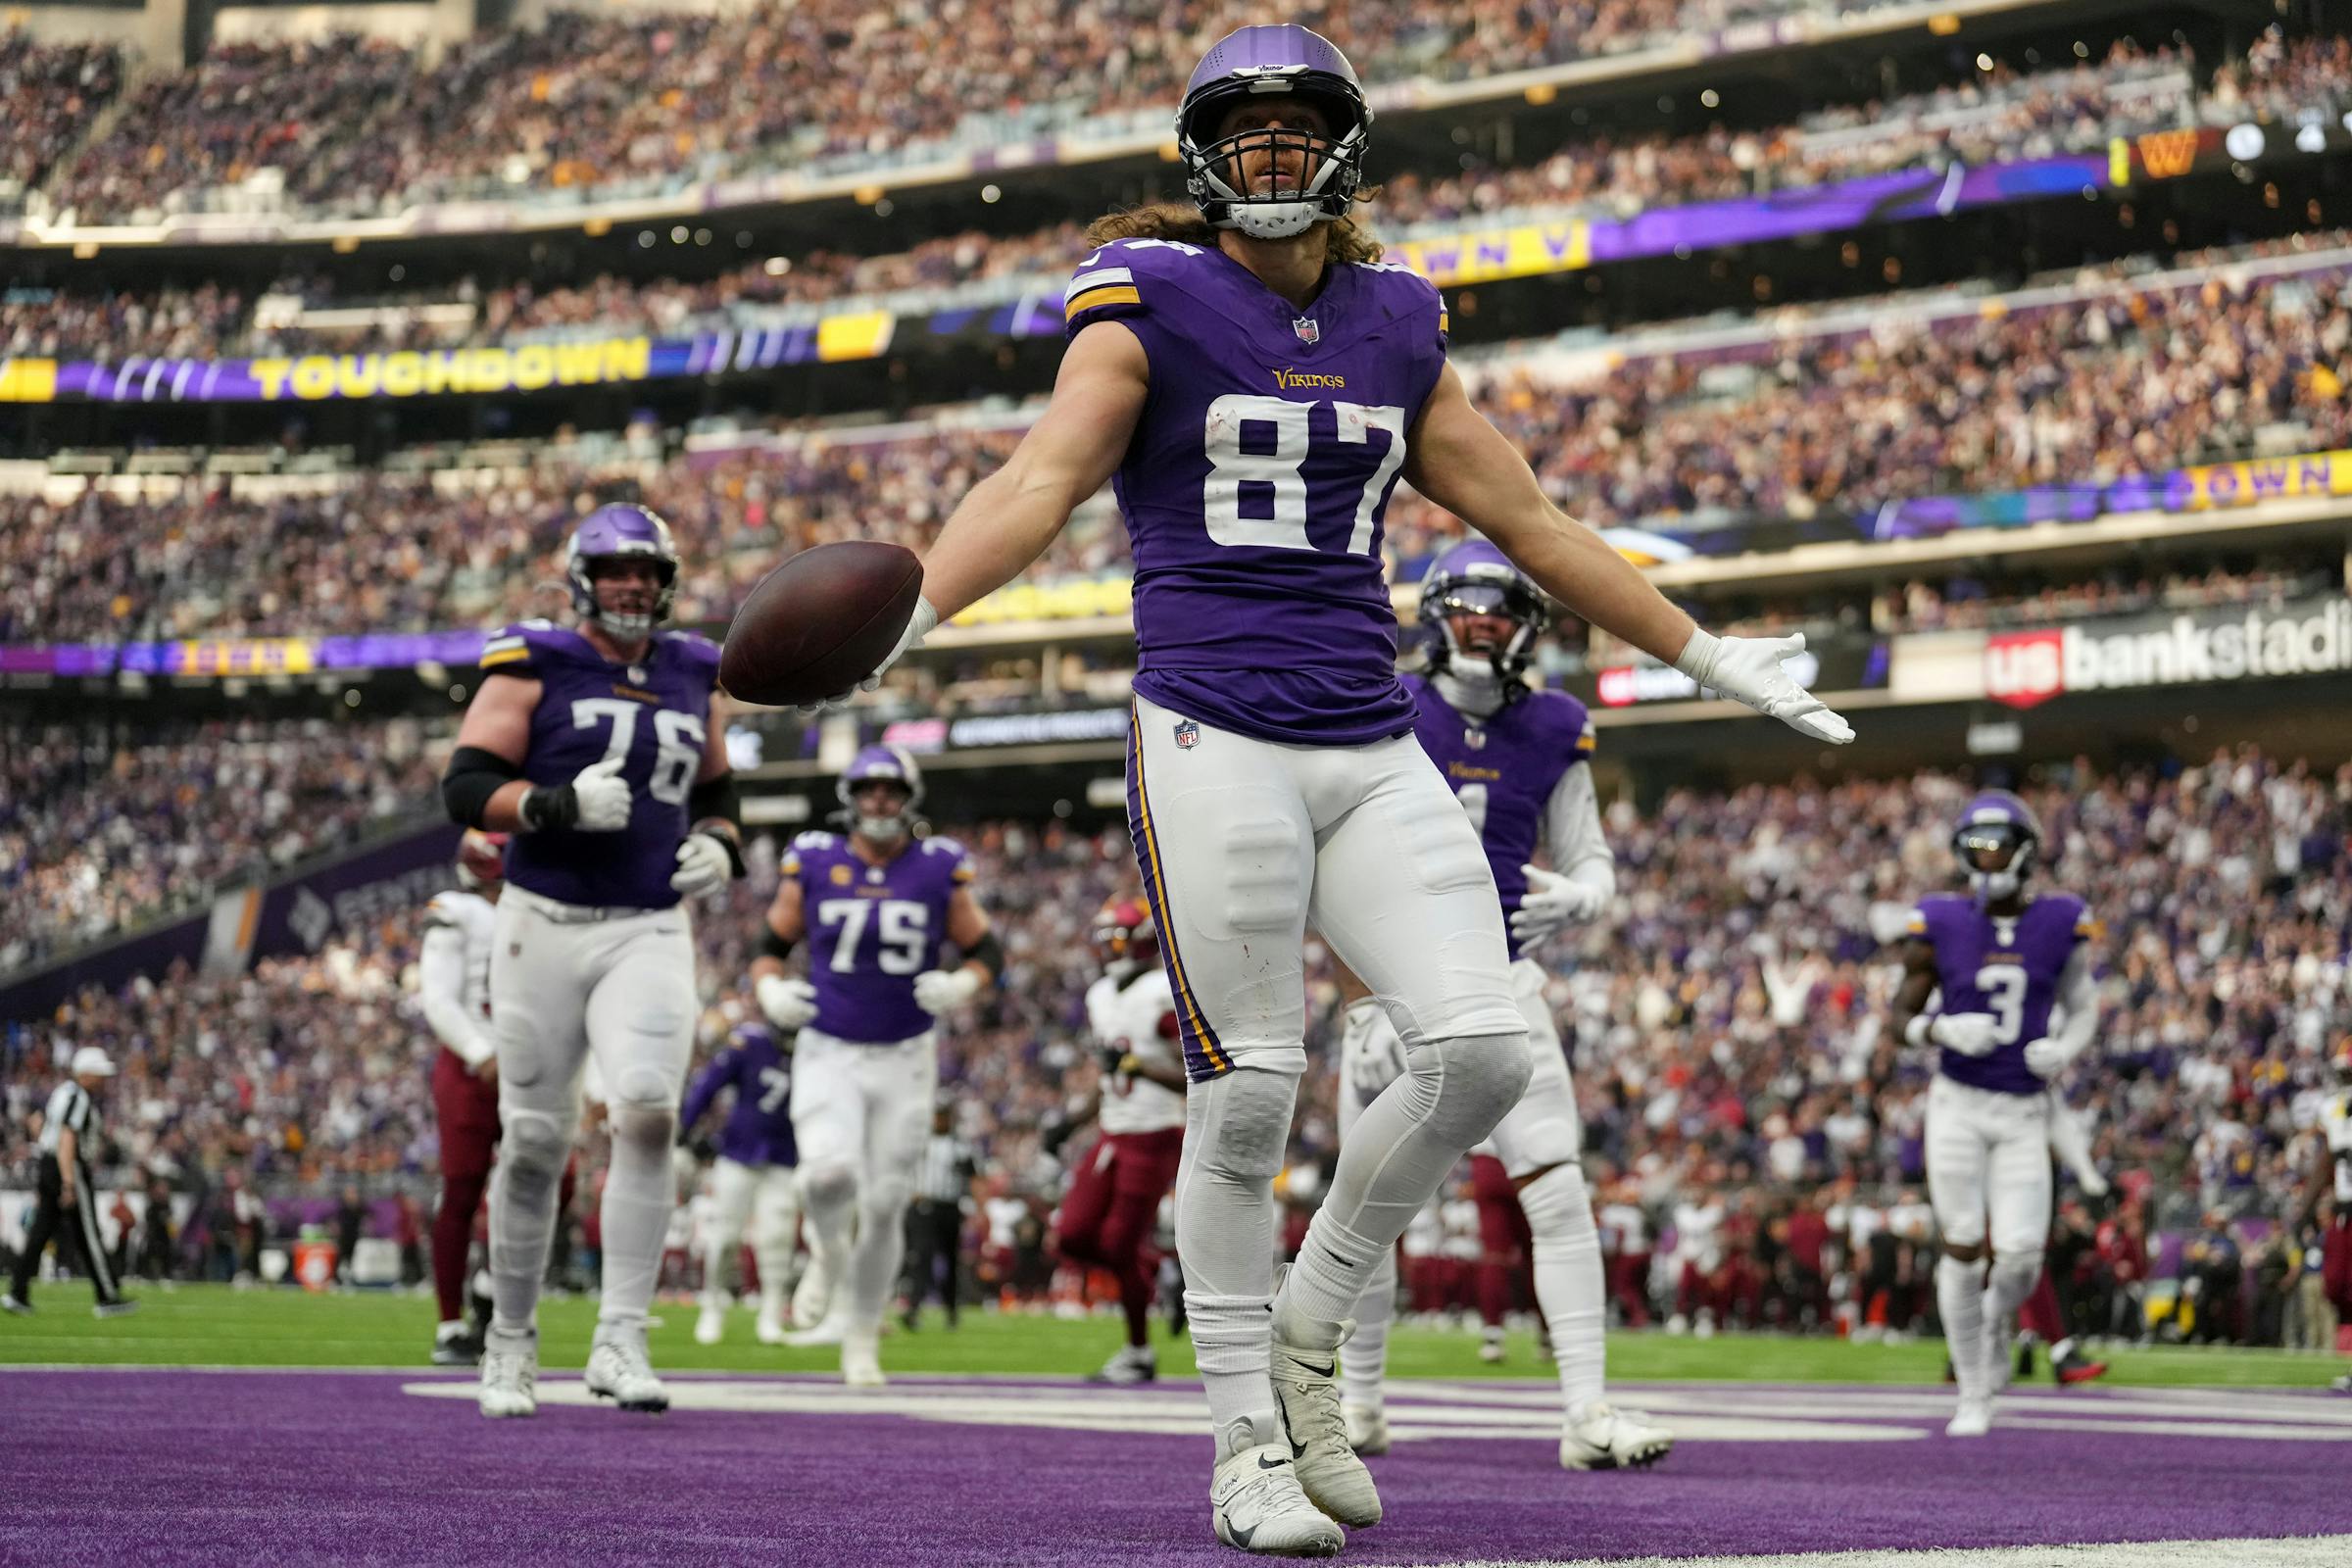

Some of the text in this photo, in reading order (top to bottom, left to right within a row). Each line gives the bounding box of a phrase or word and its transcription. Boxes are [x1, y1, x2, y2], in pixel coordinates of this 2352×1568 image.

[249, 336, 652, 401] TOUCHDOWN
[1204, 394, 1406, 556] 87
[570, 698, 706, 806] 76
[1179, 731, 1197, 745] NFL
[818, 899, 928, 975] 75
[1975, 963, 2028, 1046] 3
